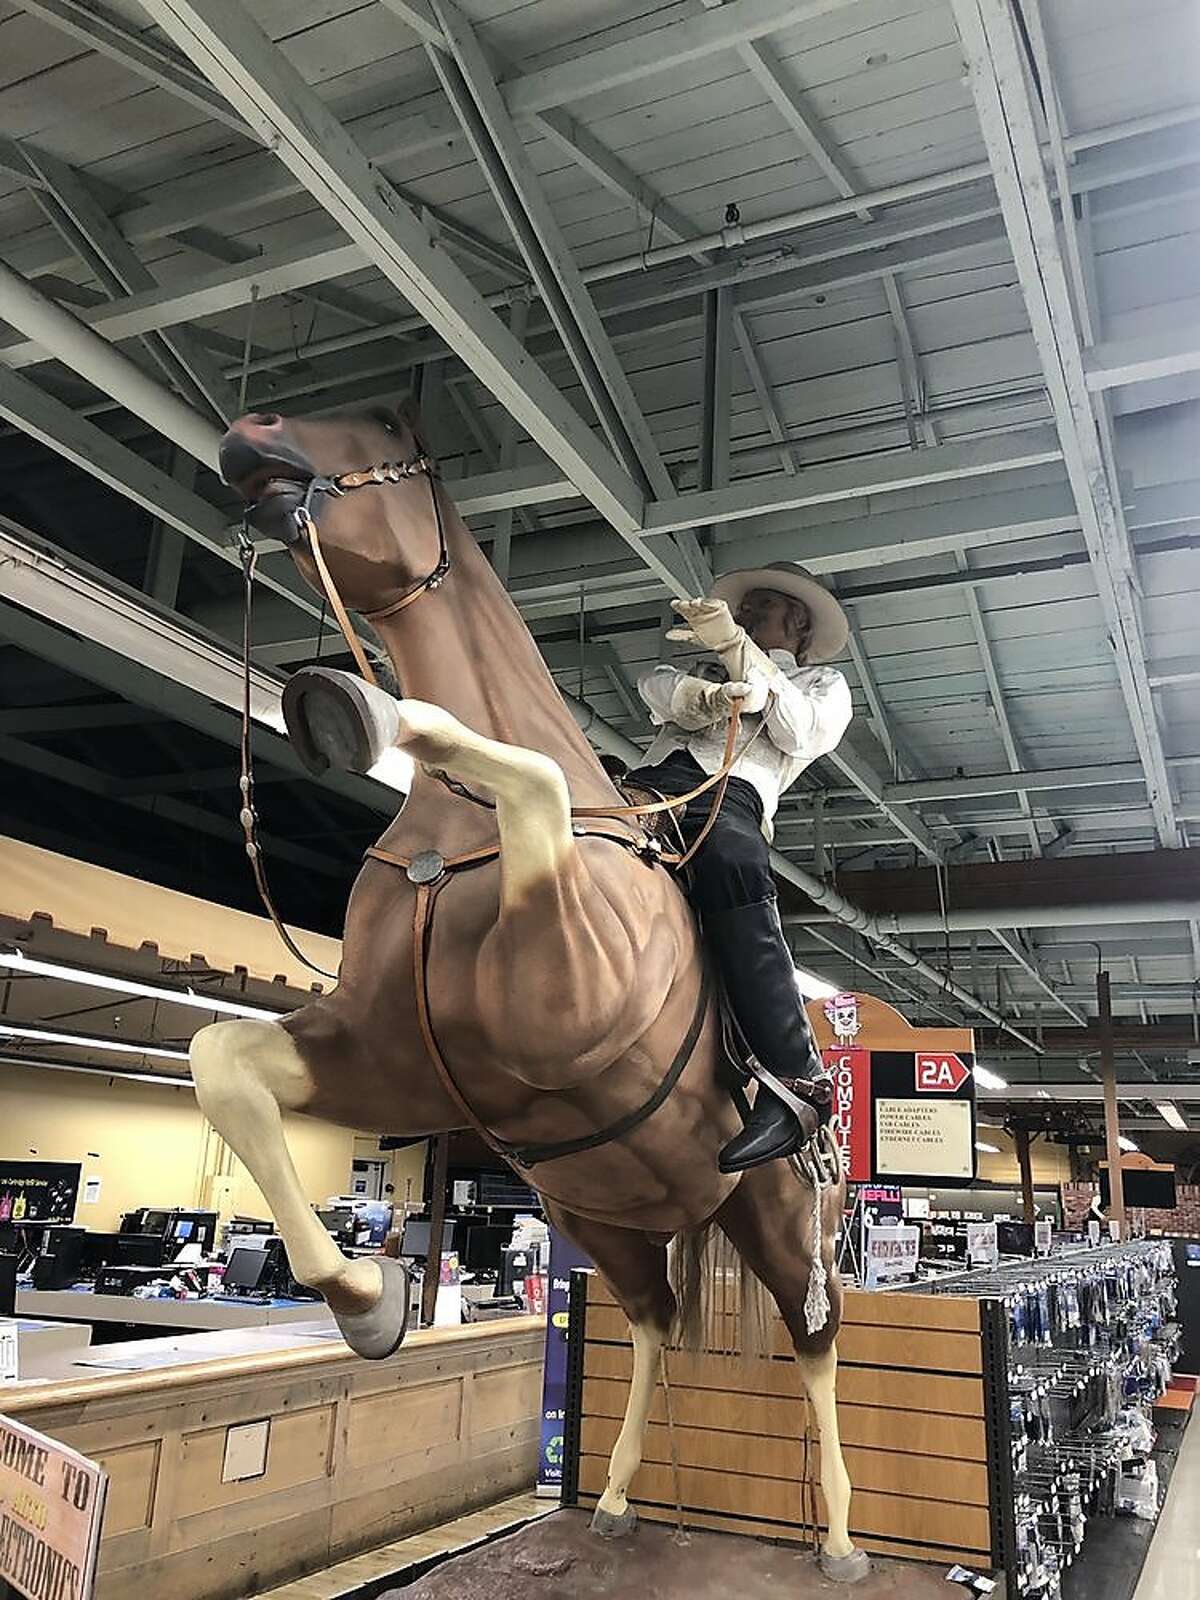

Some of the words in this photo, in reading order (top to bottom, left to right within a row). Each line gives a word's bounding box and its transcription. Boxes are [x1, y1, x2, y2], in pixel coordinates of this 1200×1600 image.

[921, 1060, 955, 1085] 2A
[837, 1056, 854, 1176] COMPUTER
[62, 1460, 91, 1512] TO
